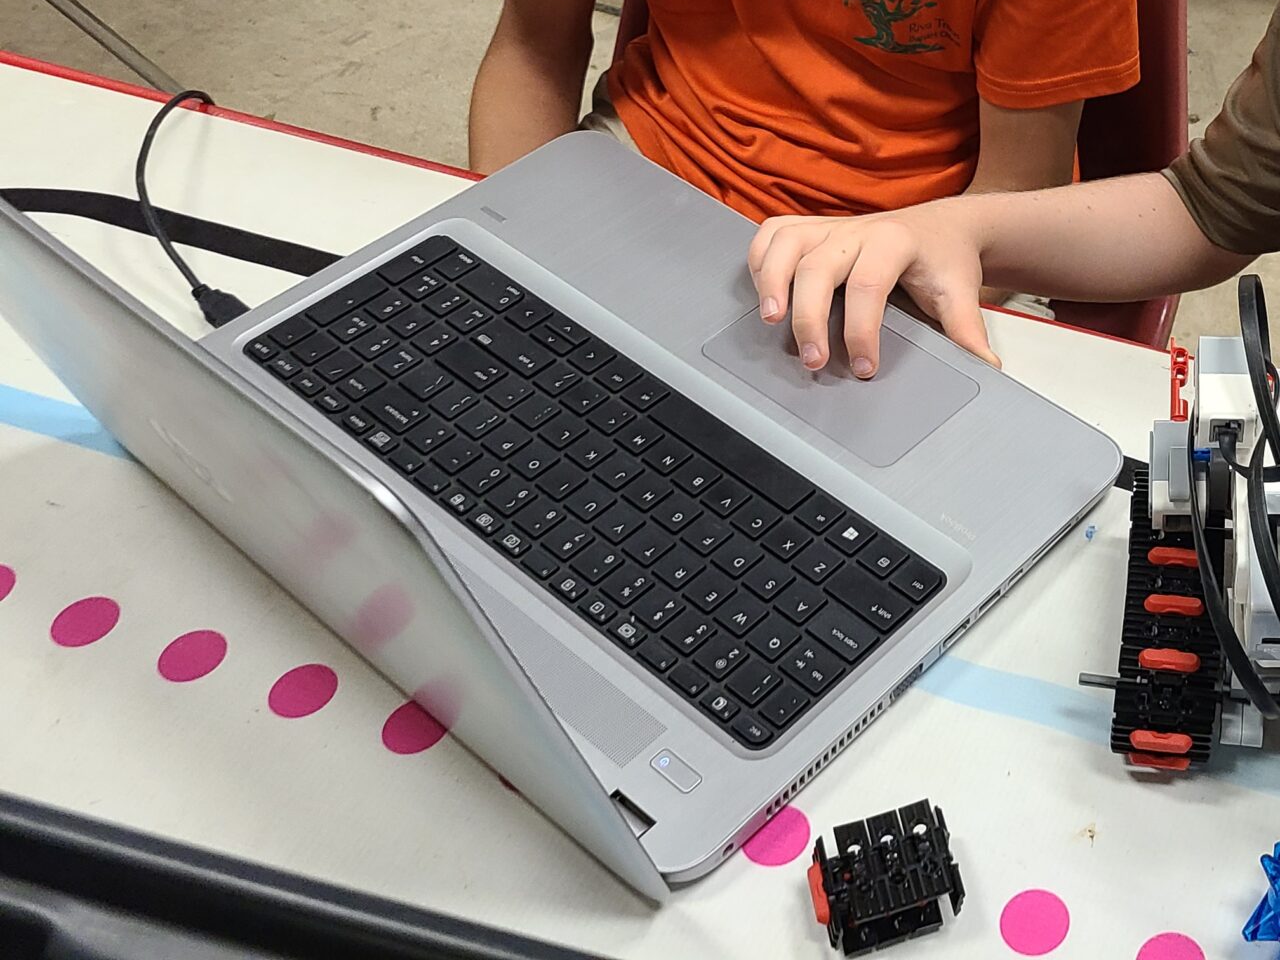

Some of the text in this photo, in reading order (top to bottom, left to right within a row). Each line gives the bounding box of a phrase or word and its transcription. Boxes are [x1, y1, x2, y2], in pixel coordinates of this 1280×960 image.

[560, 432, 570, 440] L
[632, 436, 646, 444] M
[586, 450, 598, 460] K
[528, 460, 540, 468] O
[662, 456, 674, 466] N
[692, 478, 704, 486] B
[518, 490, 528, 498] 9
[642, 492, 654, 502] H
[584, 502, 596, 512] U
[720, 498, 732, 508] V
[546, 510, 556, 520] 8
[672, 512, 684, 522] G
[752, 518, 762, 528] C
[614, 524, 624, 534] Y
[574, 534, 584, 542] 7
[702, 538, 714, 546] F
[782, 540, 794, 550] X
[644, 548, 654, 556] T
[604, 556, 614, 564] 6
[734, 558, 746, 568] D
[814, 562, 826, 572] Z
[674, 568, 686, 578] R
[634, 578, 644, 586] 5
[766, 580, 776, 590] S
[912, 580, 924, 590] ctrl
[706, 592, 718, 602] E
[664, 600, 674, 608] 4
[798, 602, 808, 612] A
[732, 612, 748, 624] W
[878, 608, 892, 618] shift
[696, 624, 706, 634] 3
[768, 638, 780, 648] Q
[832, 628, 858, 649] caps lock
[728, 648, 740, 658] 2
[716, 658, 728, 668] @
[762, 674, 772, 684] 1
[812, 670, 824, 682] tab
